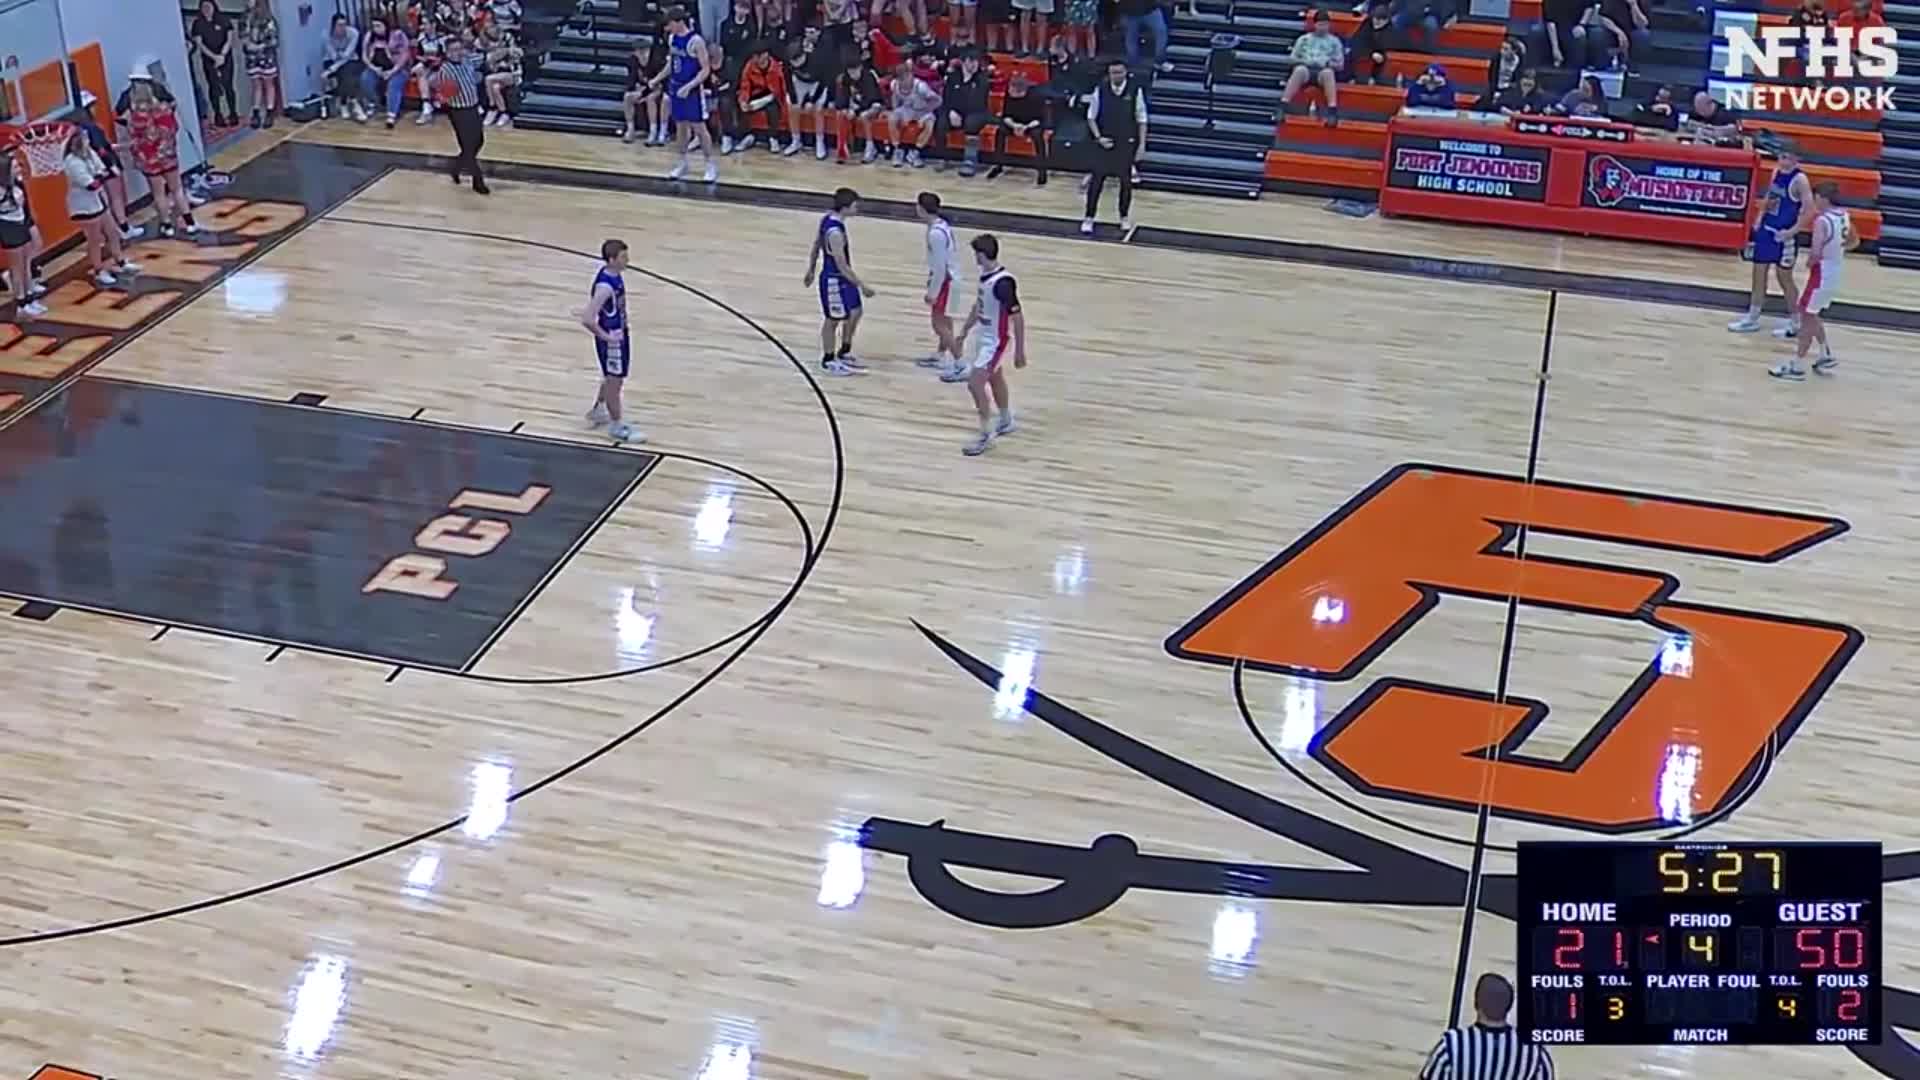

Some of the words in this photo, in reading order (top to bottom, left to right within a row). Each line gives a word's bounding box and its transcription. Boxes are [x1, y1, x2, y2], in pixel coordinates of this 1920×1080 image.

[1439, 140, 1487, 153] WELCOME
[1489, 145, 1501, 155] TO
[1655, 165, 1685, 177] HOME
[1686, 168, 1701, 179] OF
[1702, 170, 1723, 182] THE
[1417, 175, 1452, 190] HIGH
[1456, 178, 1513, 196] SCHOOL
[1624, 175, 1748, 209] MUSKETEERS
[0, 198, 308, 413] EERS
